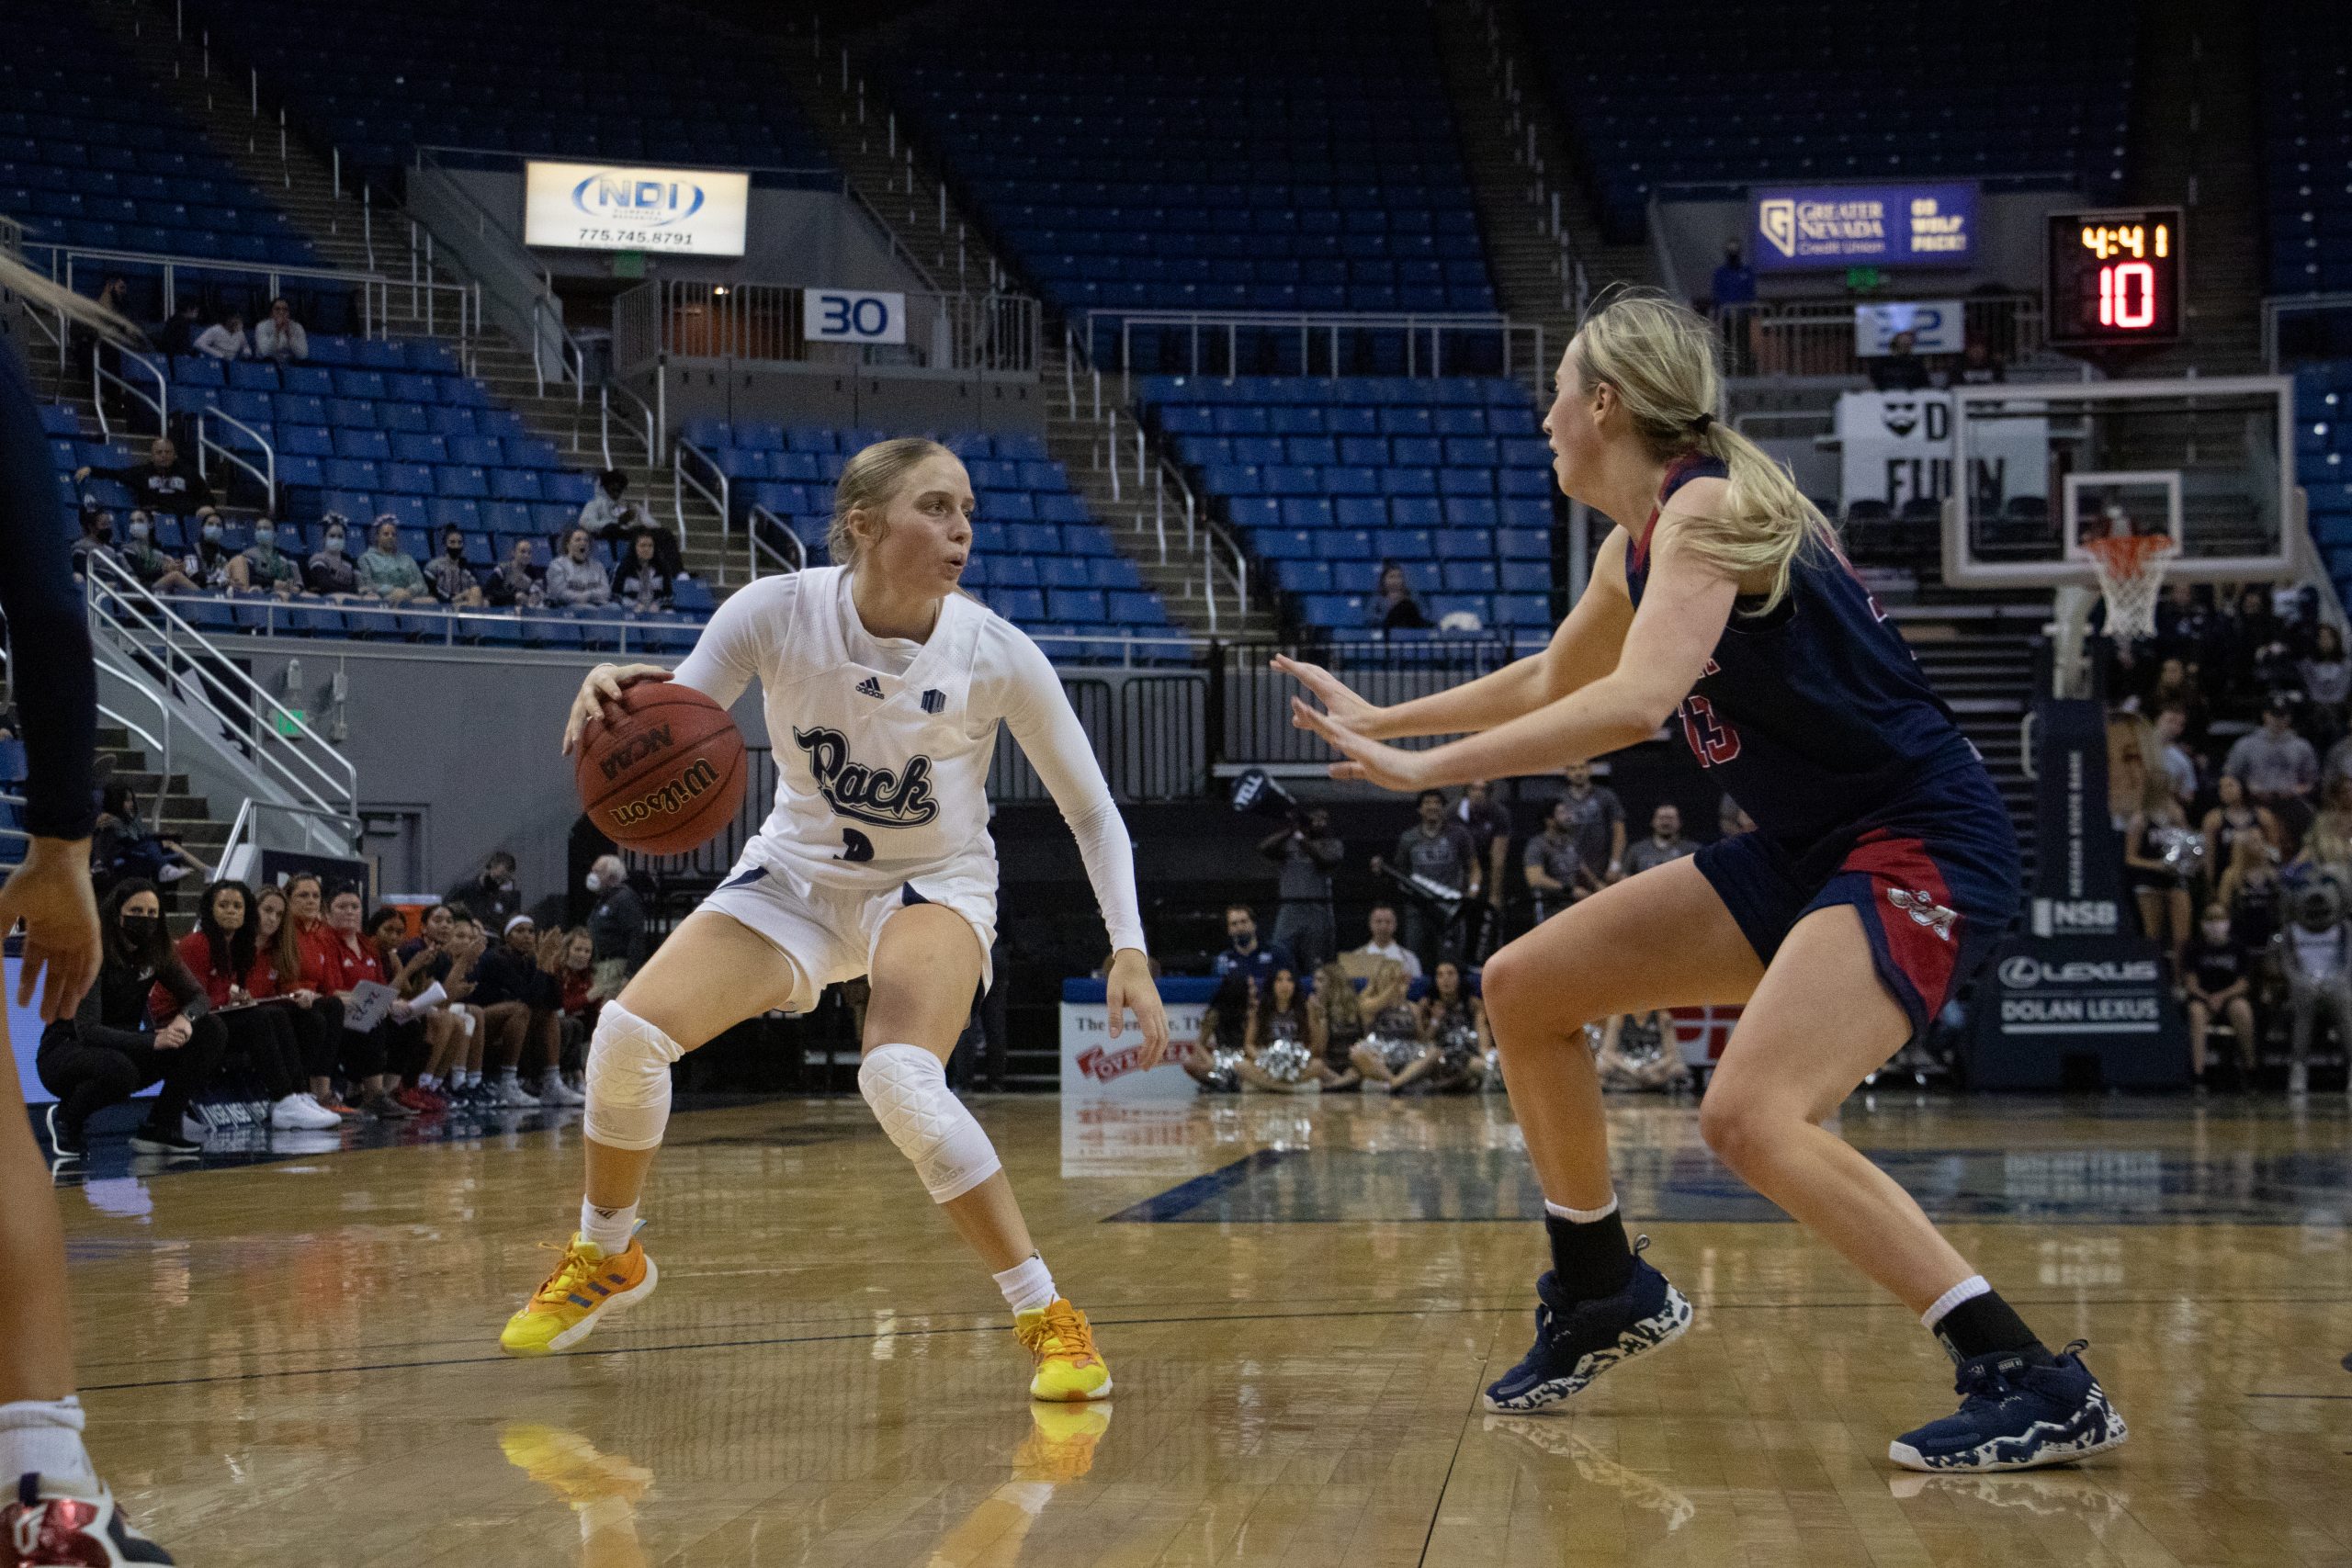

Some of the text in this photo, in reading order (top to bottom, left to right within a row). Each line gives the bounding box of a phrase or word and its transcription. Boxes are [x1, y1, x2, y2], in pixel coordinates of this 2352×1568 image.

[598, 177, 679, 210] NDI
[1796, 201, 1883, 220] GREATER
[579, 229, 694, 245] 775.745.8791
[1798, 219, 1884, 239] NEVADA
[2081, 224, 2168, 259] 4:41
[2099, 263, 2154, 328] 10
[820, 296, 889, 336] 30
[855, 684, 886, 700] adidas
[1677, 695, 1742, 768] 13
[600, 721, 675, 784] NCAA
[609, 758, 720, 826] Wilson
[793, 726, 941, 829] Pack
[2054, 900, 2118, 926] NSB
[2041, 962, 2158, 982] LEXUS
[2000, 998, 2159, 1021] DOLAN LEXUS
[1077, 1017, 1105, 1032] The
